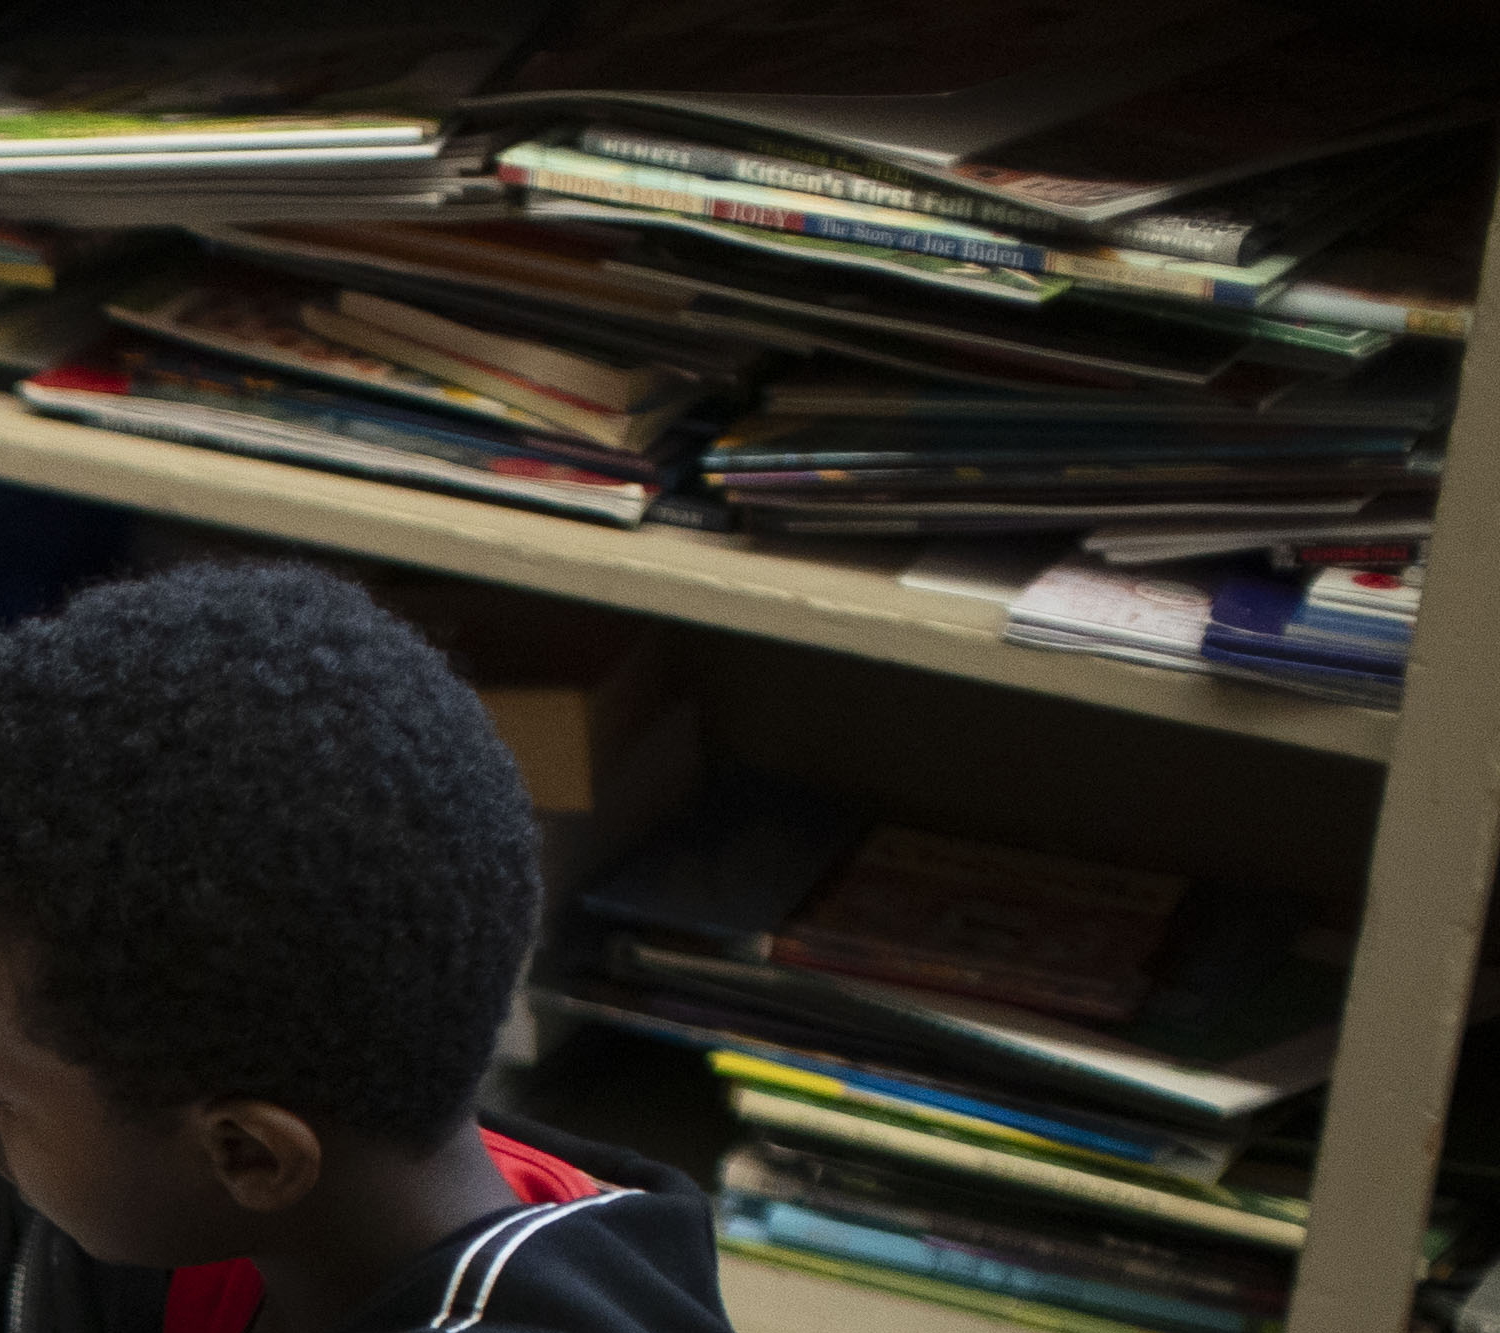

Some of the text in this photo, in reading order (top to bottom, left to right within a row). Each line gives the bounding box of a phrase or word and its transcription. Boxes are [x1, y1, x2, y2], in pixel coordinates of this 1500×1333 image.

[727, 201, 791, 230] JOEY
[734, 158, 844, 200] Kitten's
[850, 177, 914, 208] First
[921, 191, 975, 220] Full
[819, 216, 848, 238] The
[854, 222, 897, 251] Story
[922, 232, 958, 258] Joe
[963, 236, 1025, 270] Biden
